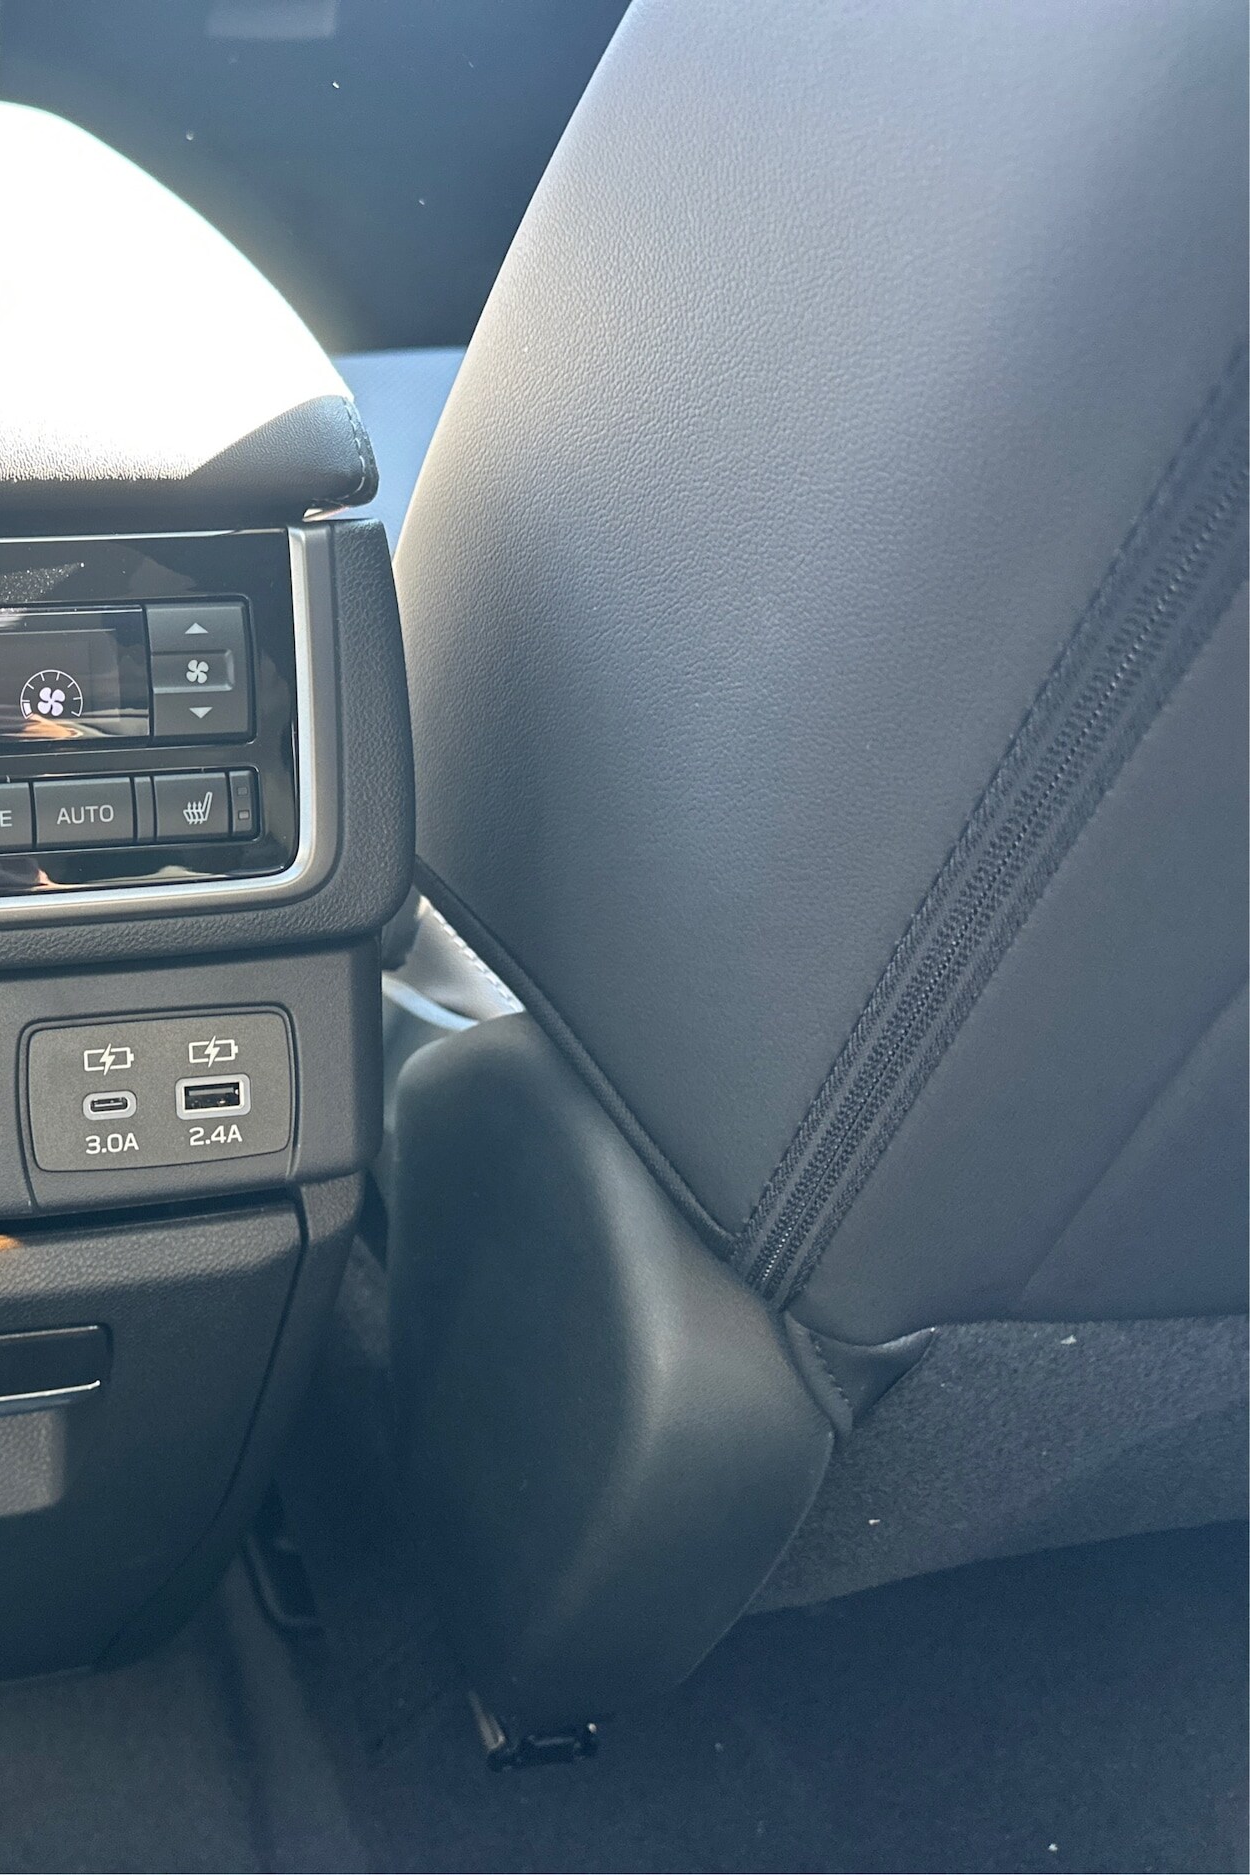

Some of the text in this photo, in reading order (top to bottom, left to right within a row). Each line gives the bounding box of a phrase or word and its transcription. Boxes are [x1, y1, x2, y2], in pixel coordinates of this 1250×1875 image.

[56, 804, 115, 826] AUTO
[85, 1132, 140, 1155] 3.0A
[188, 1123, 243, 1146] 2.4A
